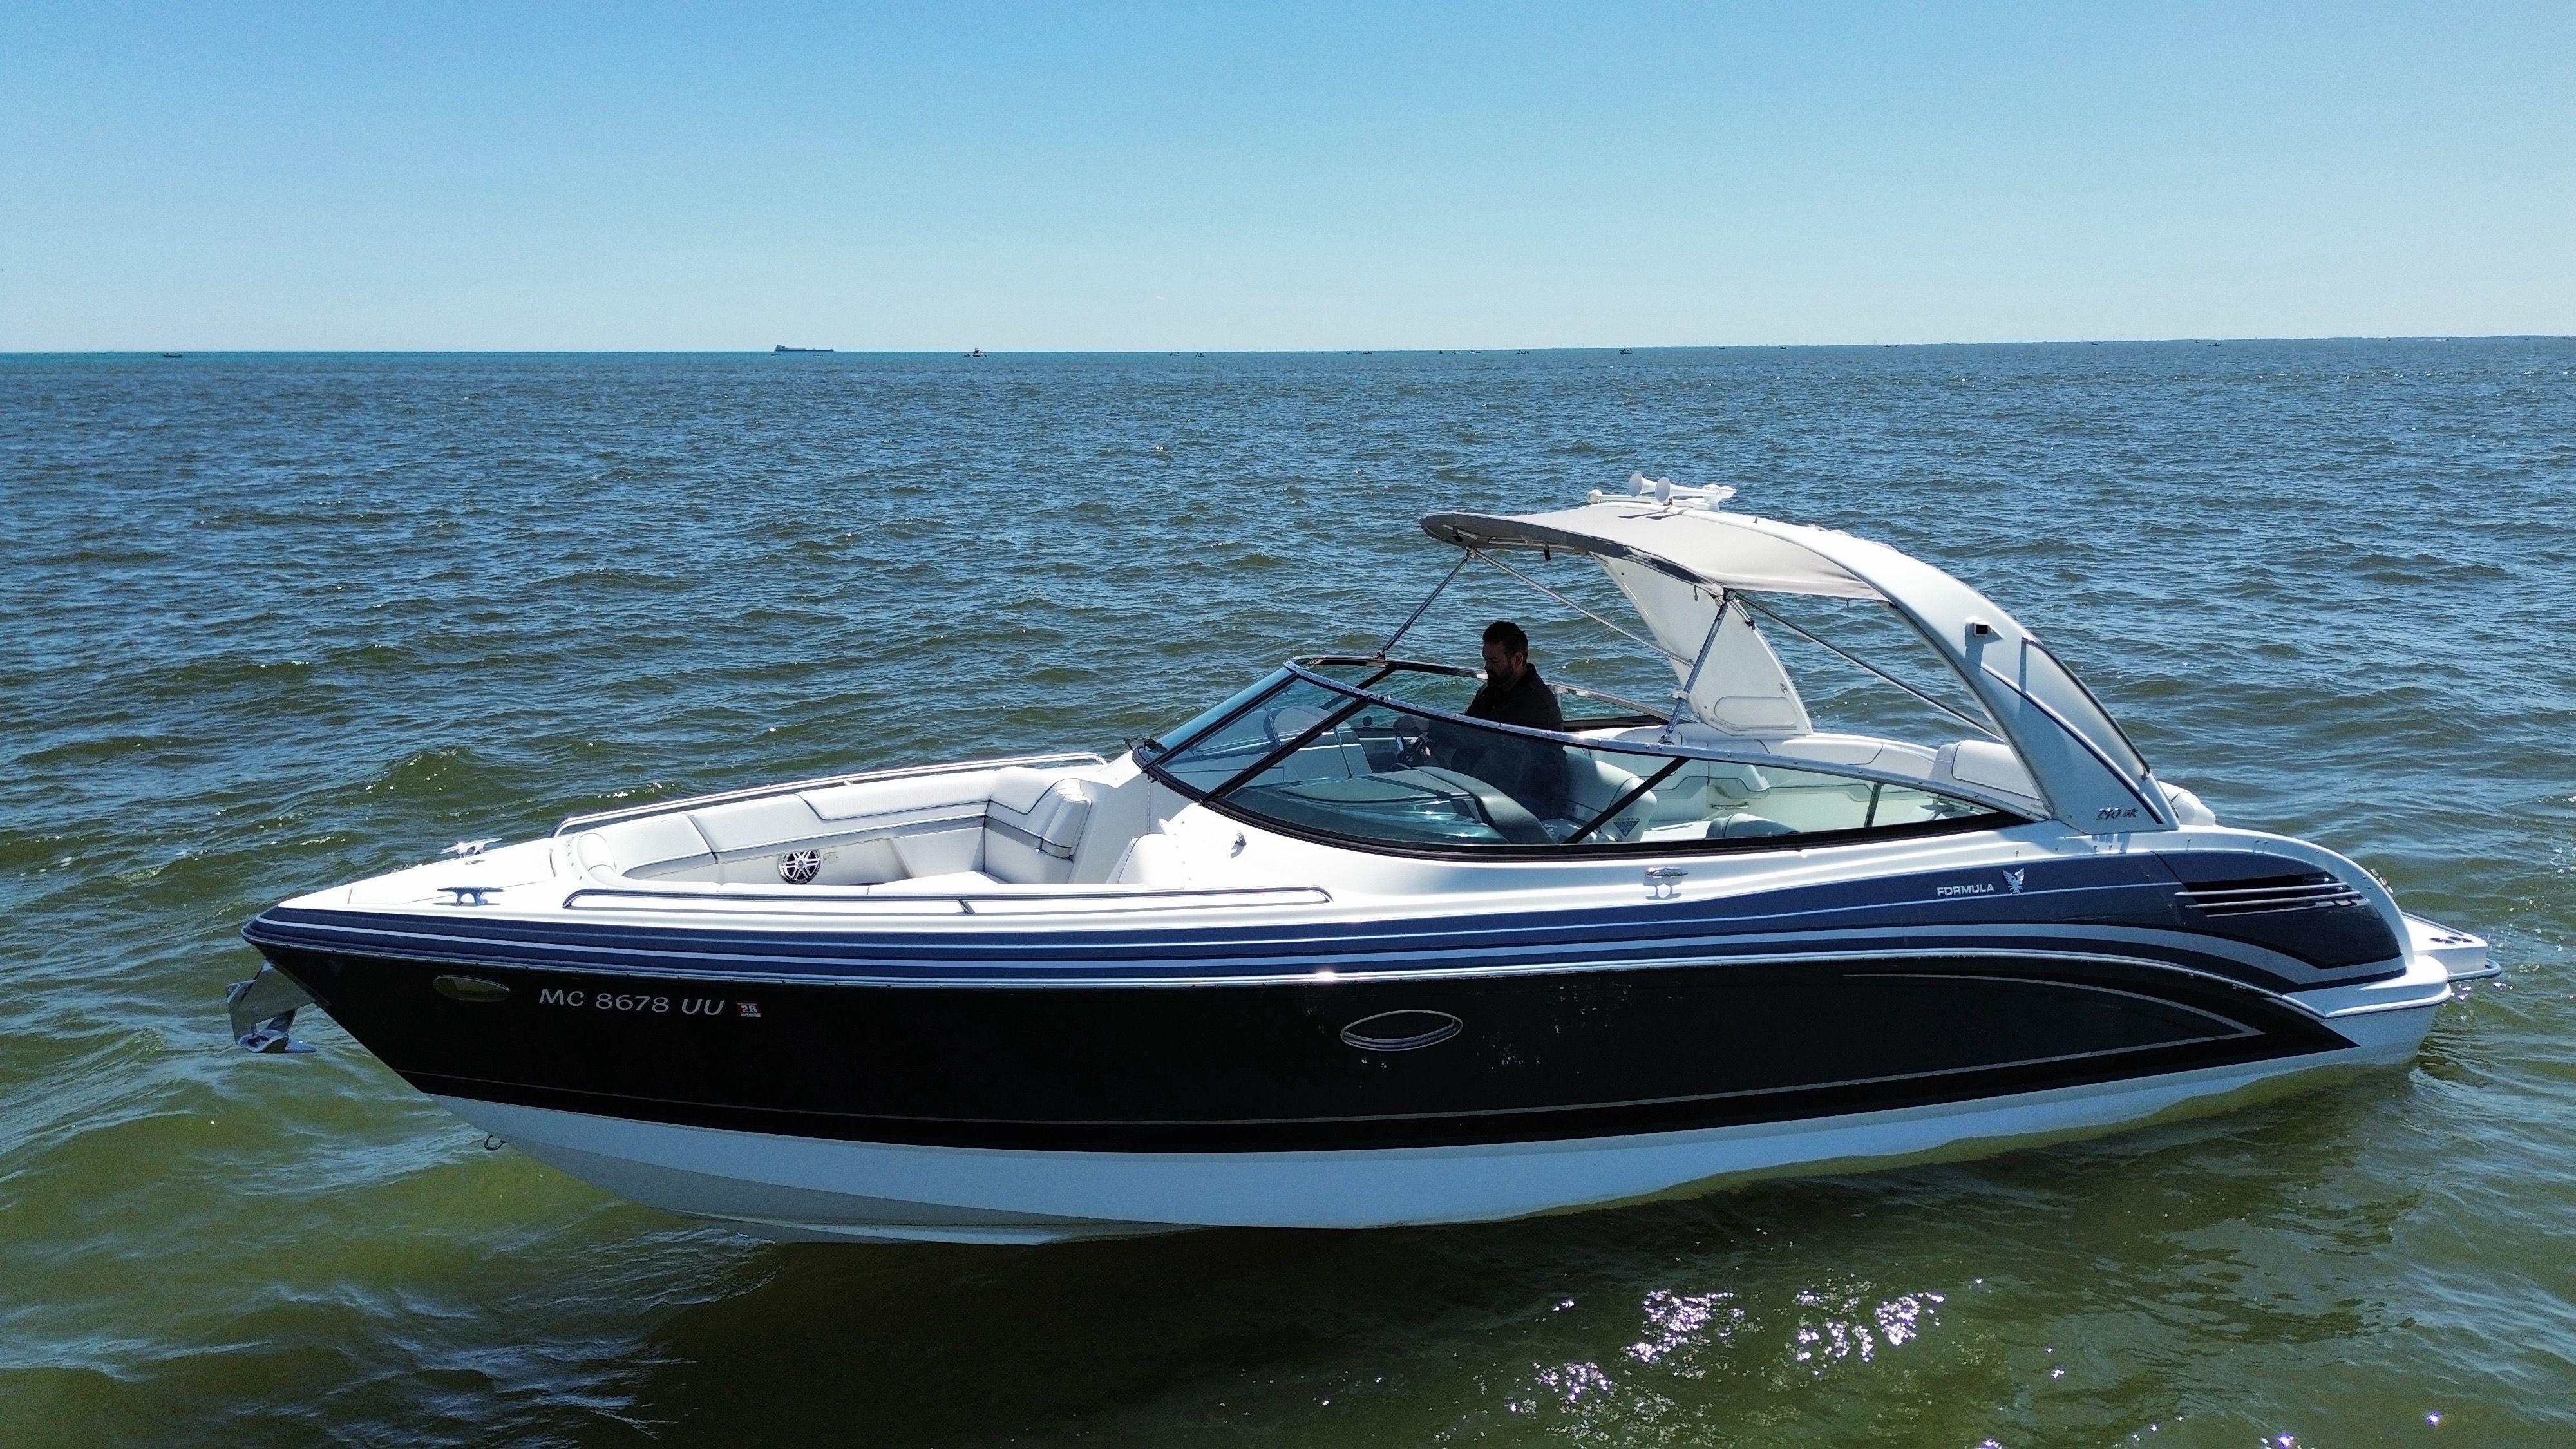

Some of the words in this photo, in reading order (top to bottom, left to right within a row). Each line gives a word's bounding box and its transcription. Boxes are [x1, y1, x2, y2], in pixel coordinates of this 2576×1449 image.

[1937, 884, 1994, 896] FORMULA
[539, 989, 584, 1007] MC
[595, 993, 669, 1013] 8678
[681, 999, 725, 1015] UU
